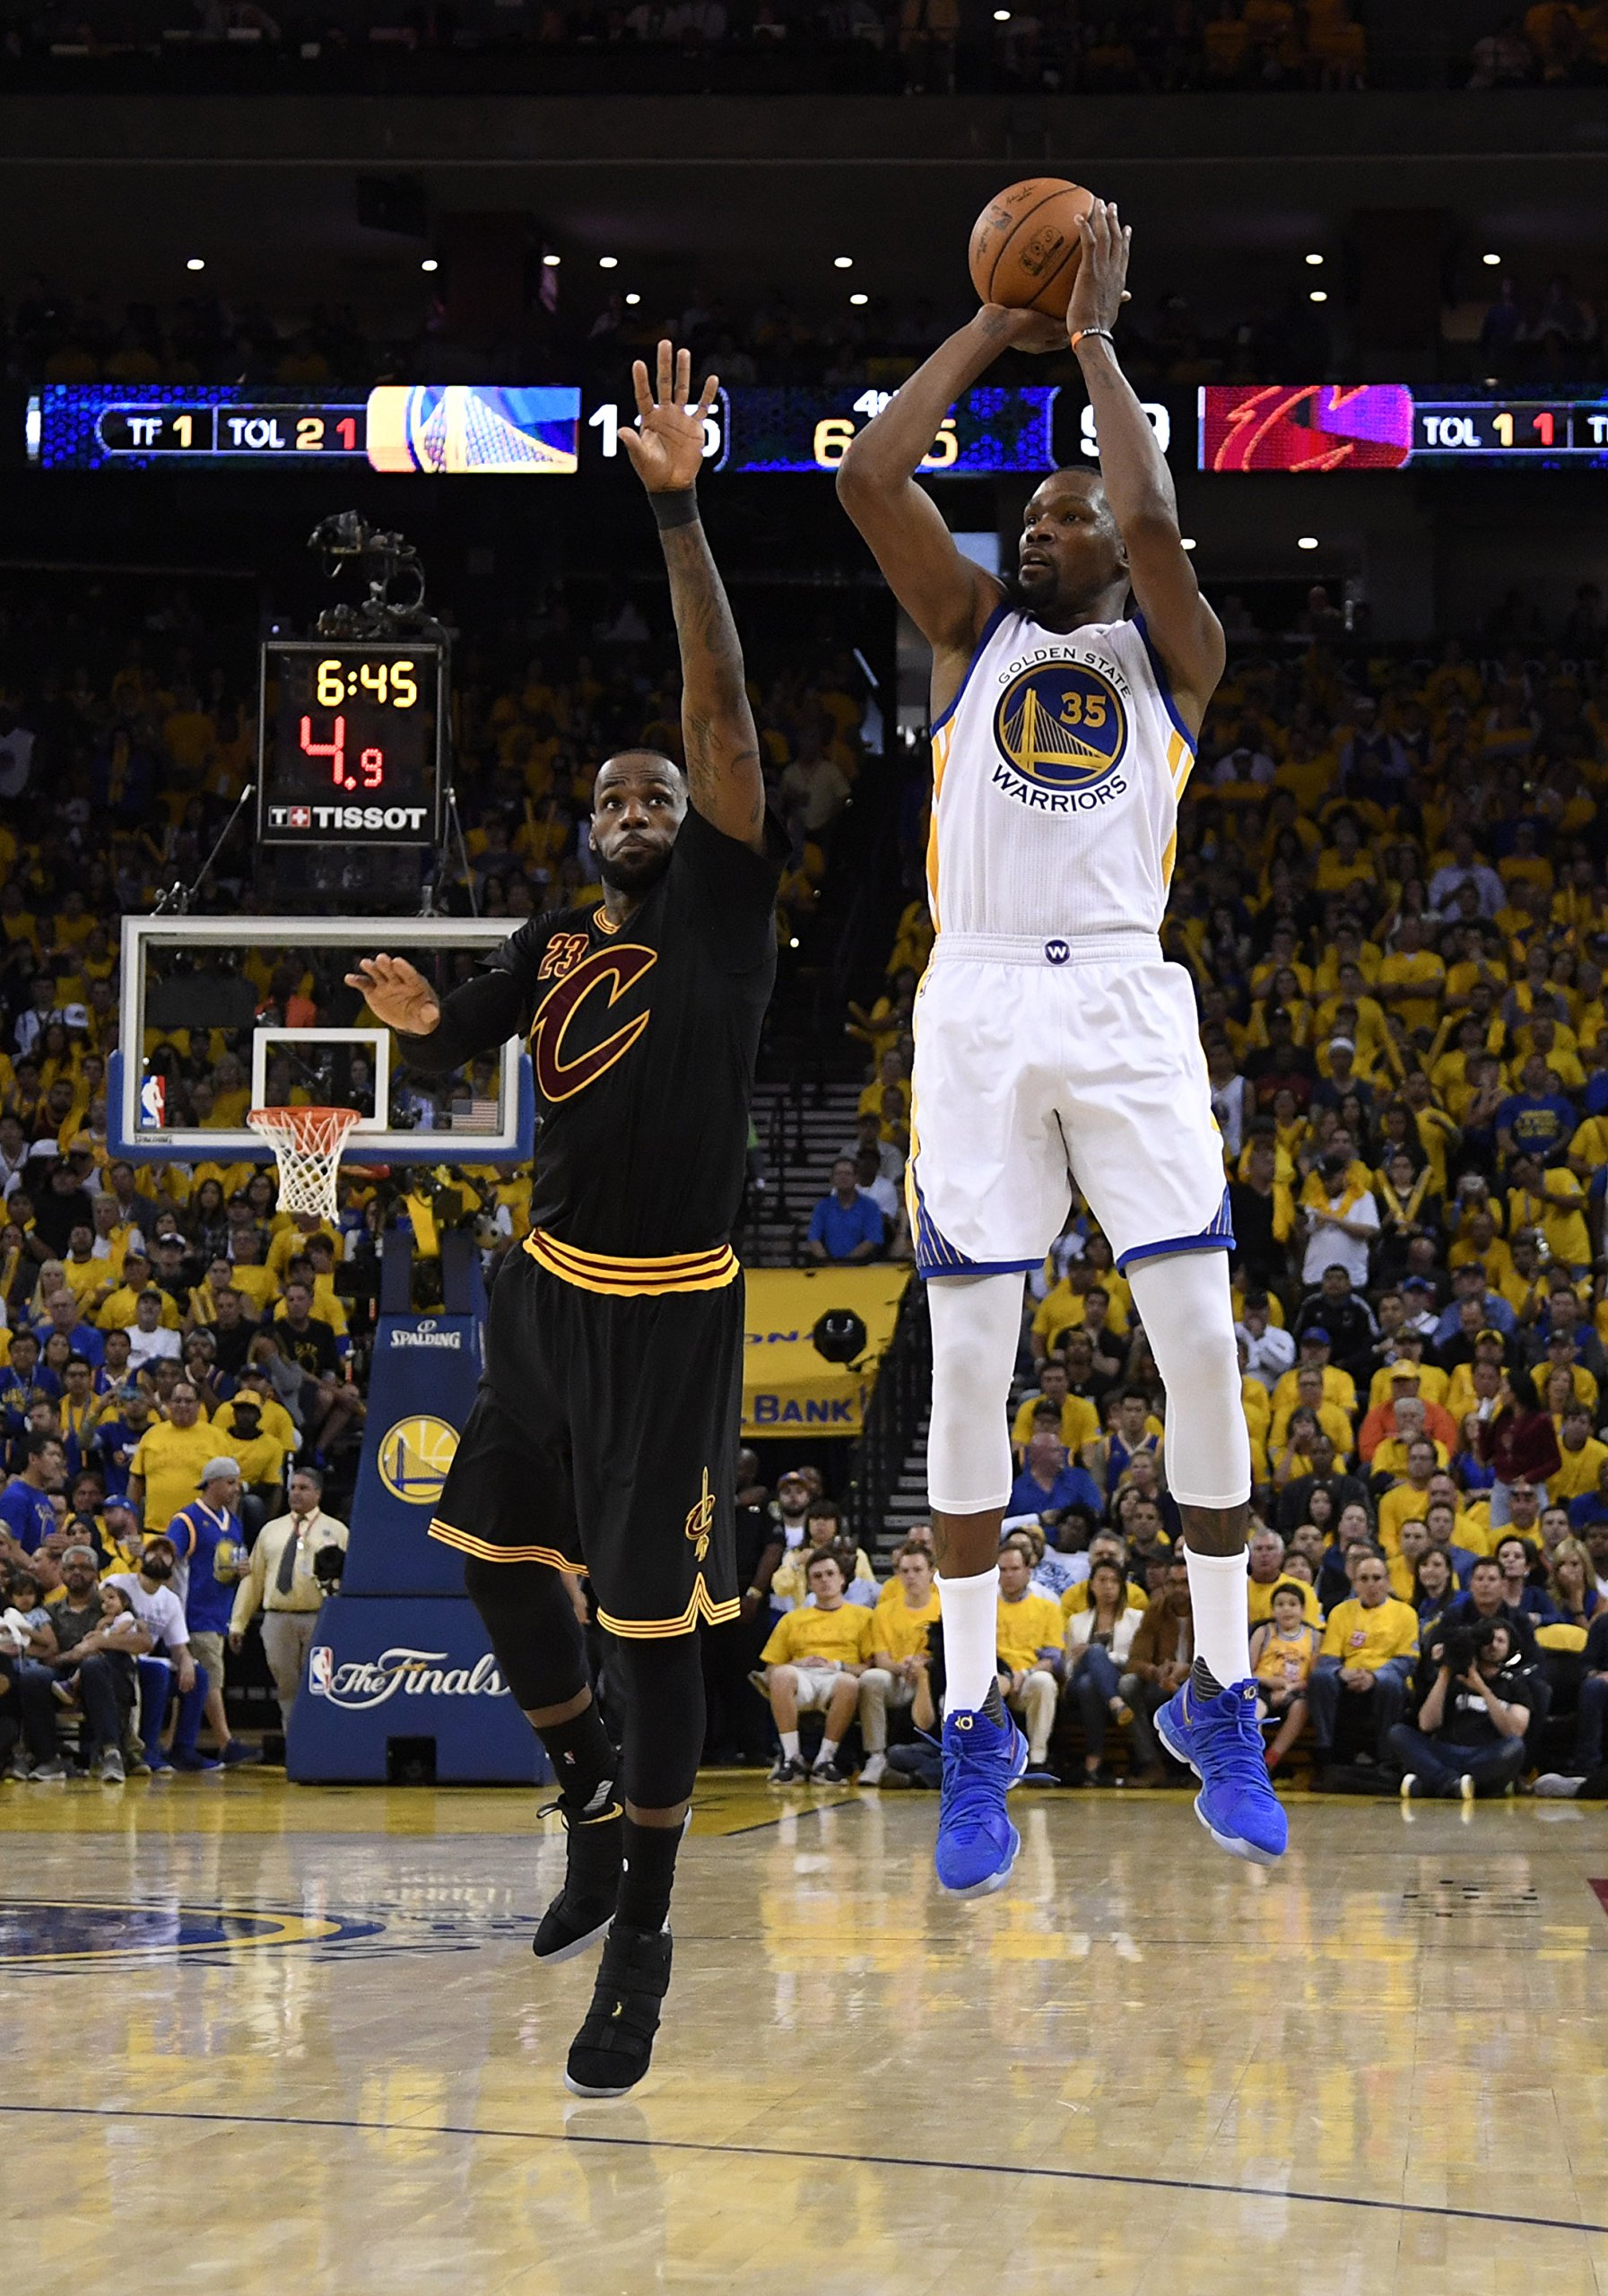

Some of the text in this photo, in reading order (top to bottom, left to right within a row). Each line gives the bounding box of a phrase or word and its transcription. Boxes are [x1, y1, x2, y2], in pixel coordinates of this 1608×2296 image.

[126, 415, 192, 448] TF 1
[228, 417, 356, 450] TOL 2 1
[1422, 413, 1553, 448] TOL 1 1
[1586, 414, 1608, 444] T
[317, 660, 417, 709] 6:45
[998, 648, 1132, 700] GOLDEN STATE
[1060, 691, 1107, 728] 35
[300, 716, 383, 790] 4.9
[991, 763, 1128, 813] WARRIORS
[313, 807, 428, 831] TISSOT
[537, 932, 589, 980] 23
[530, 944, 658, 1103] C
[390, 1330, 461, 1349] SPALDING
[324, 1648, 511, 1710] The Finals
